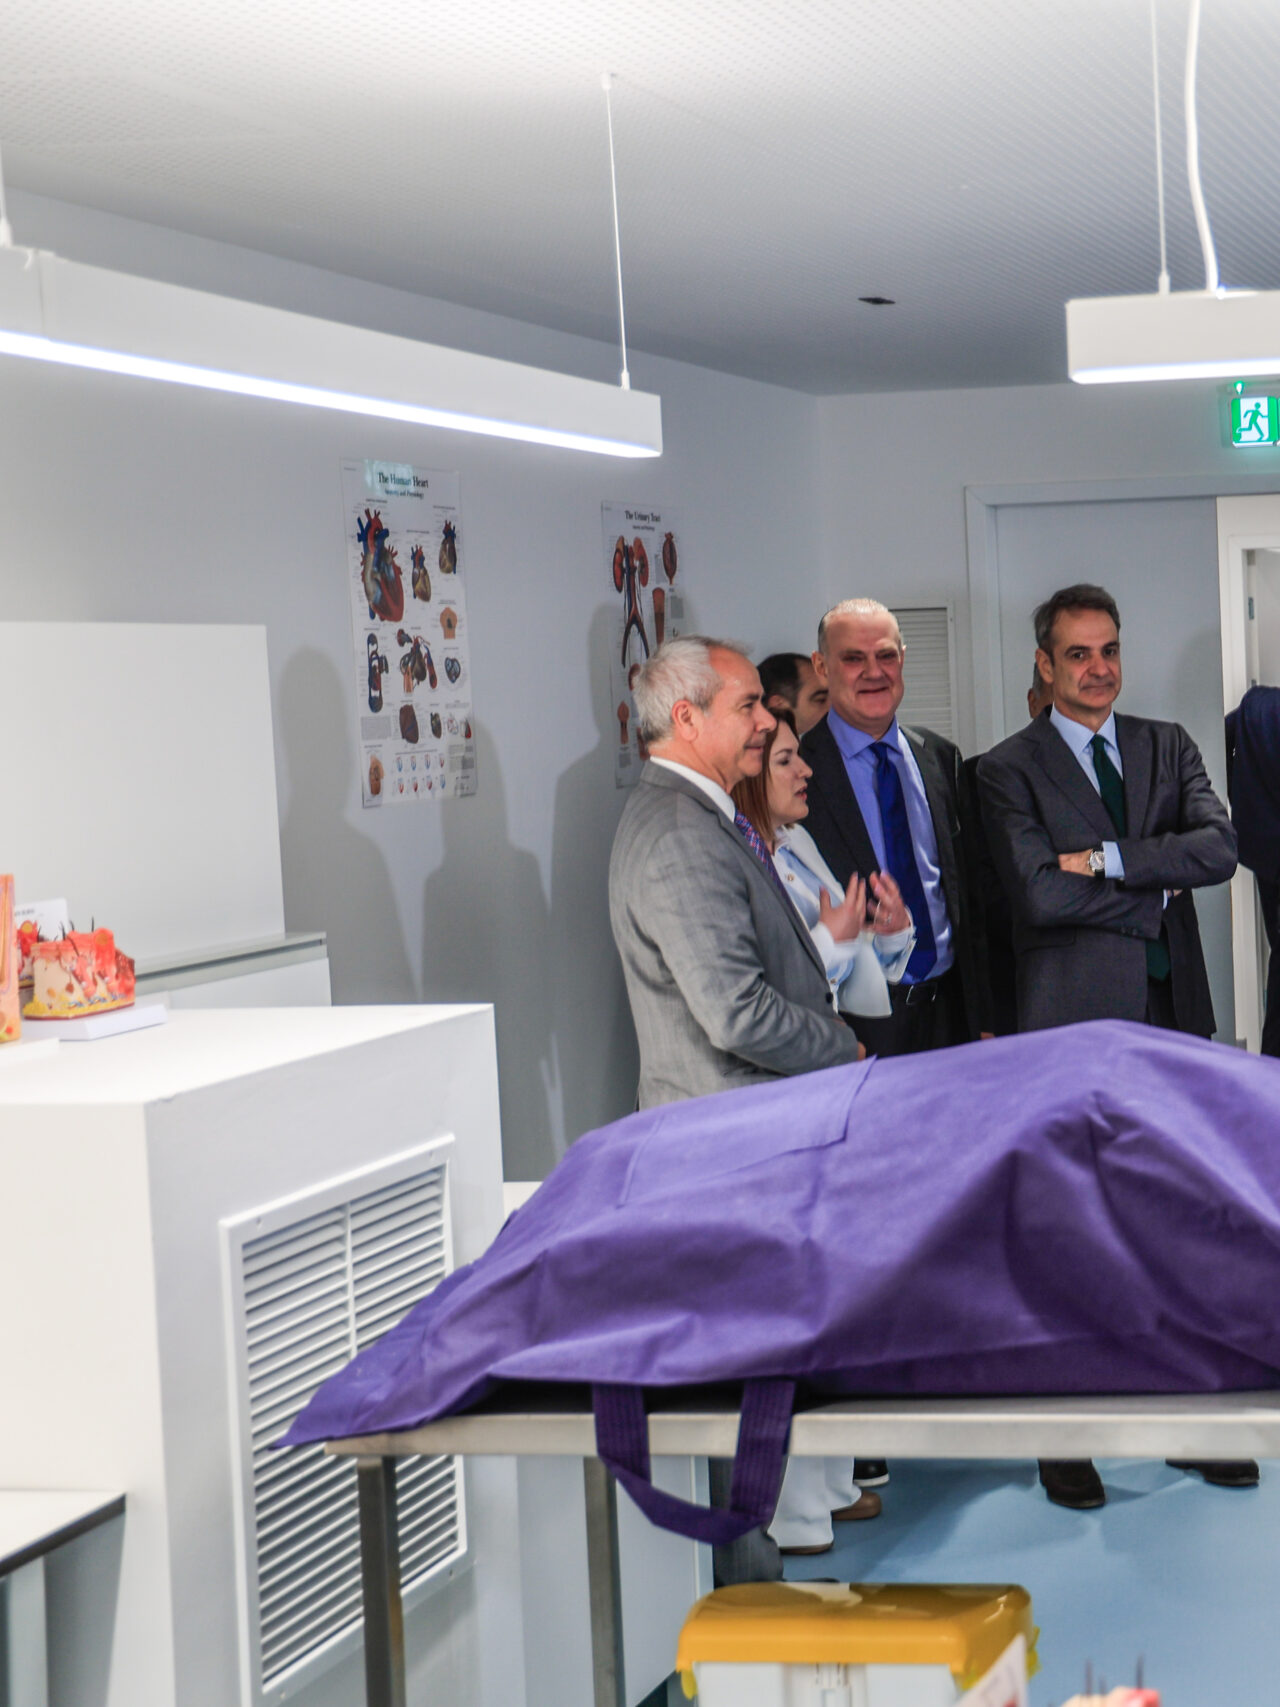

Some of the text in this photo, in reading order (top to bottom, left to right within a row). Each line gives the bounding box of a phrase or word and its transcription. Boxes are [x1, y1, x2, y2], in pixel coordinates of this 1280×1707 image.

[378, 472, 429, 488] The Human Heart
[625, 510, 633, 520] The
